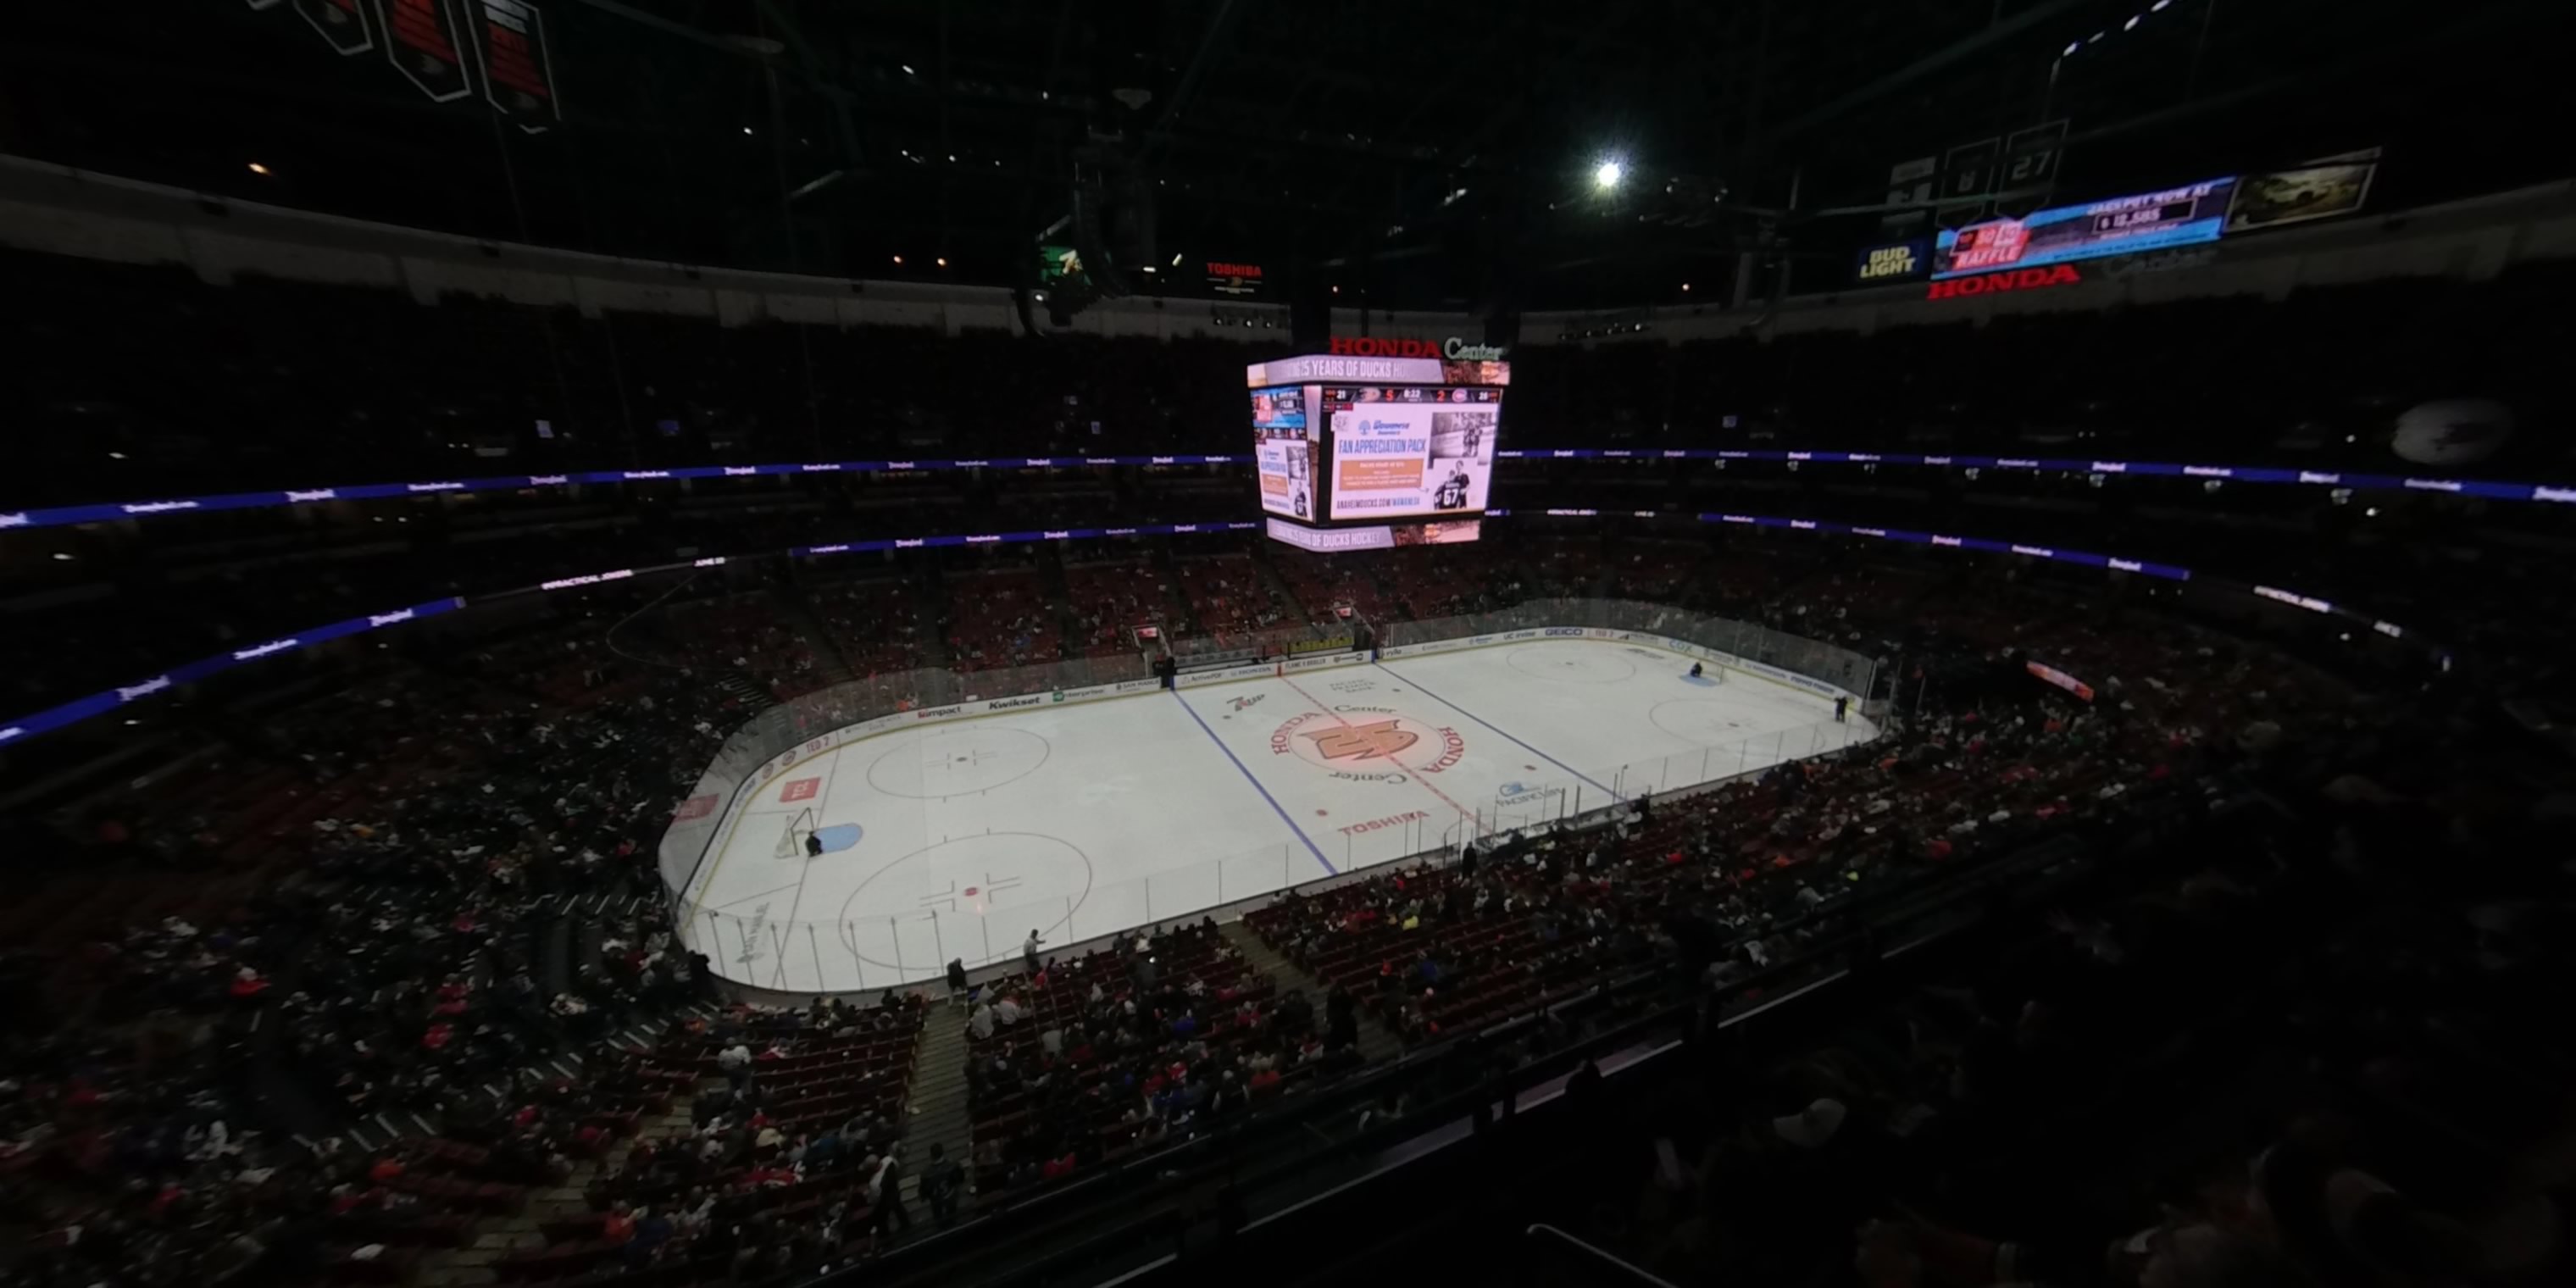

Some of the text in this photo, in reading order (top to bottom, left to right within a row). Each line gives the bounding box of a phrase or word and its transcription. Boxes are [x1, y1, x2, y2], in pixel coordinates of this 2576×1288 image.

[1869, 247, 1910, 264] BUD
[1206, 262, 1261, 276] TOSHIBA
[1859, 257, 1916, 279] LIGHT
[1926, 264, 2080, 300] HONDA
[1330, 336, 1503, 361] HONDA Center
[1313, 360, 1343, 376] YEARS
[1346, 360, 1357, 376] OF
[1360, 361, 1391, 378] DUCKS
[1339, 438, 1426, 454] FAN APPRECIATION PACK
[1444, 488, 1458, 506] 67
[1323, 534, 1350, 547] DUCKS
[1545, 628, 1583, 636] GEICO
[989, 696, 1041, 710] Kwikset
[1334, 704, 1397, 714] Center
[1270, 711, 1322, 756] HONDA
[1419, 725, 1465, 774] HONDA
[1329, 770, 1407, 785] Center
[1337, 809, 1431, 836] TOSHIBA
